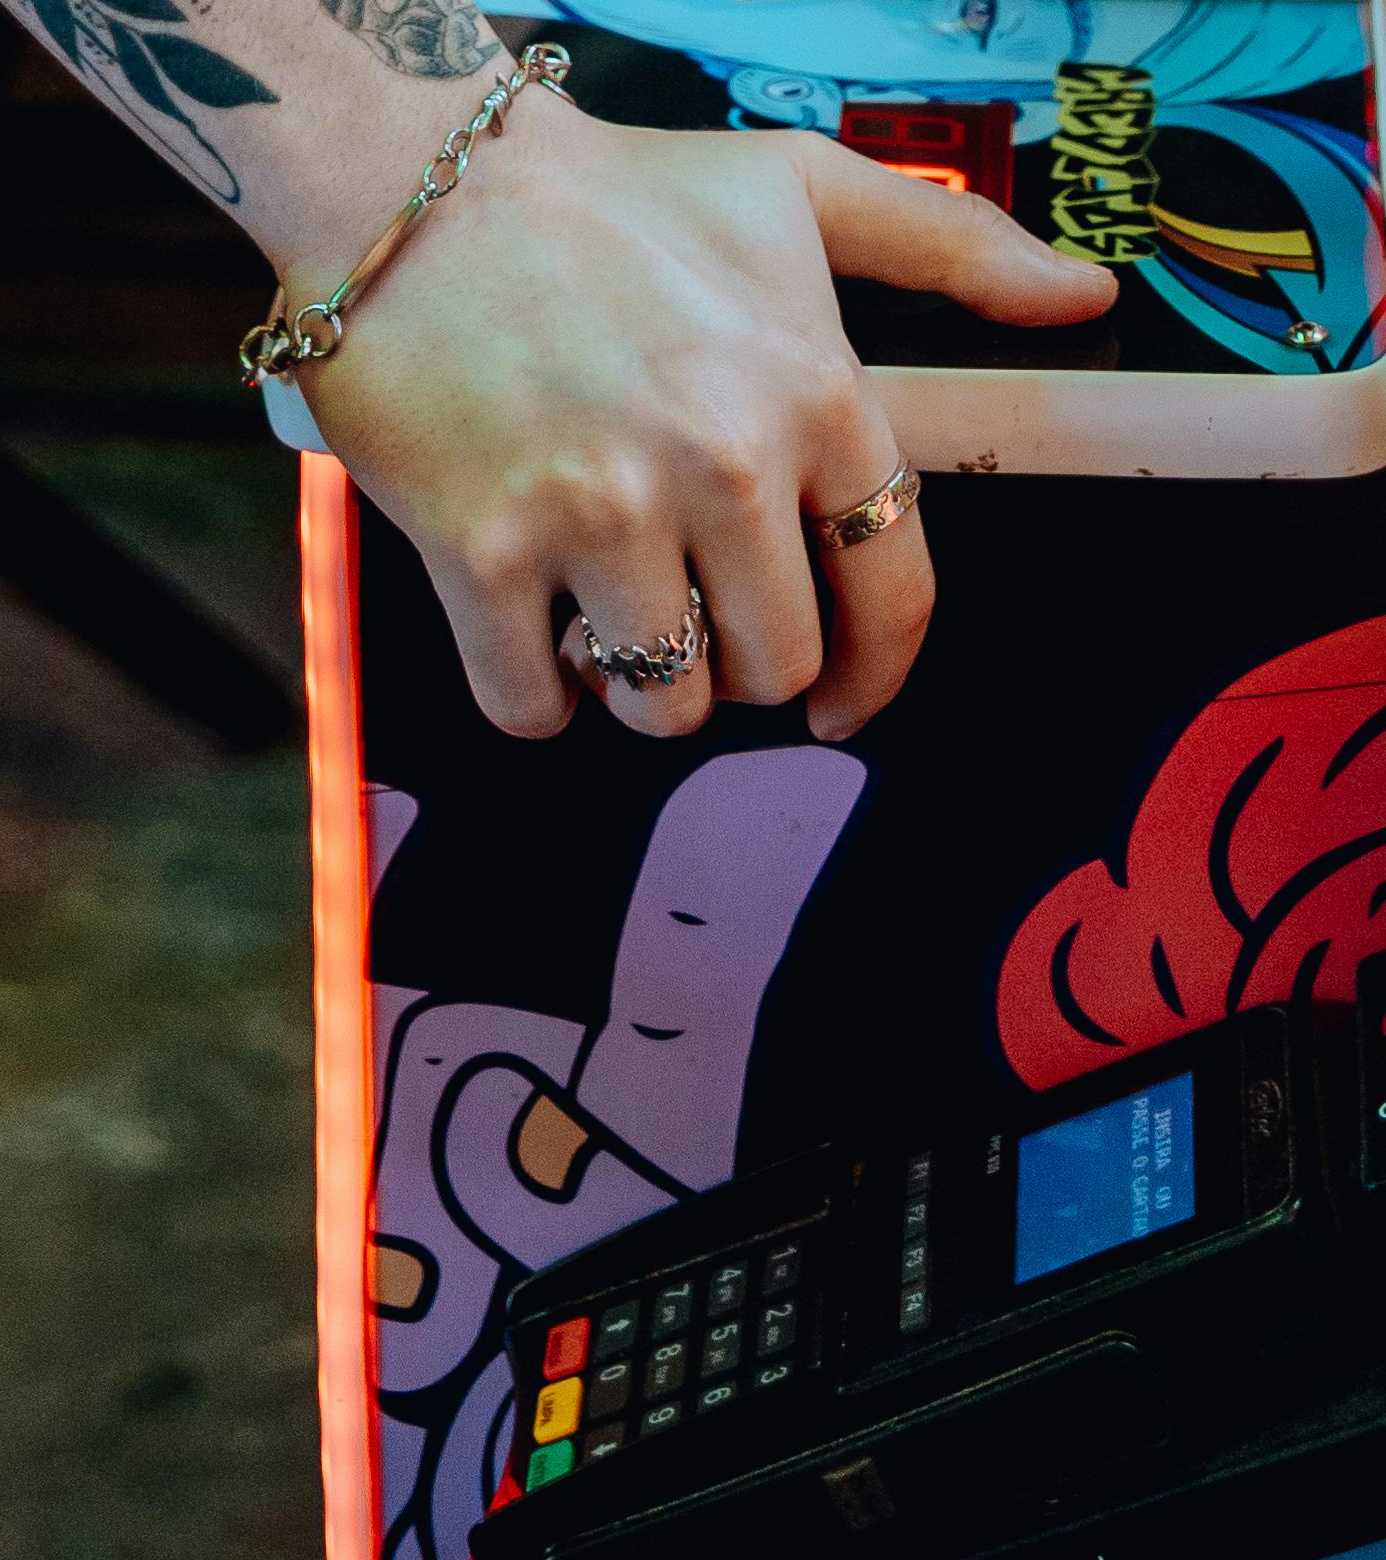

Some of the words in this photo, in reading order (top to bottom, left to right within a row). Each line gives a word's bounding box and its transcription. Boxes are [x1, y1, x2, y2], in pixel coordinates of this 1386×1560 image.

[771, 1247, 797, 1260] 1
[717, 1269, 742, 1282] 4
[665, 1283, 689, 1297] 7
[765, 1304, 794, 1322] 2
[711, 1324, 738, 1340] 5
[655, 1343, 683, 1360] 8
[600, 1365, 627, 1381] 0
[761, 1366, 787, 1383] 3
[704, 1387, 731, 1404] 6
[649, 1407, 675, 1423] 9
